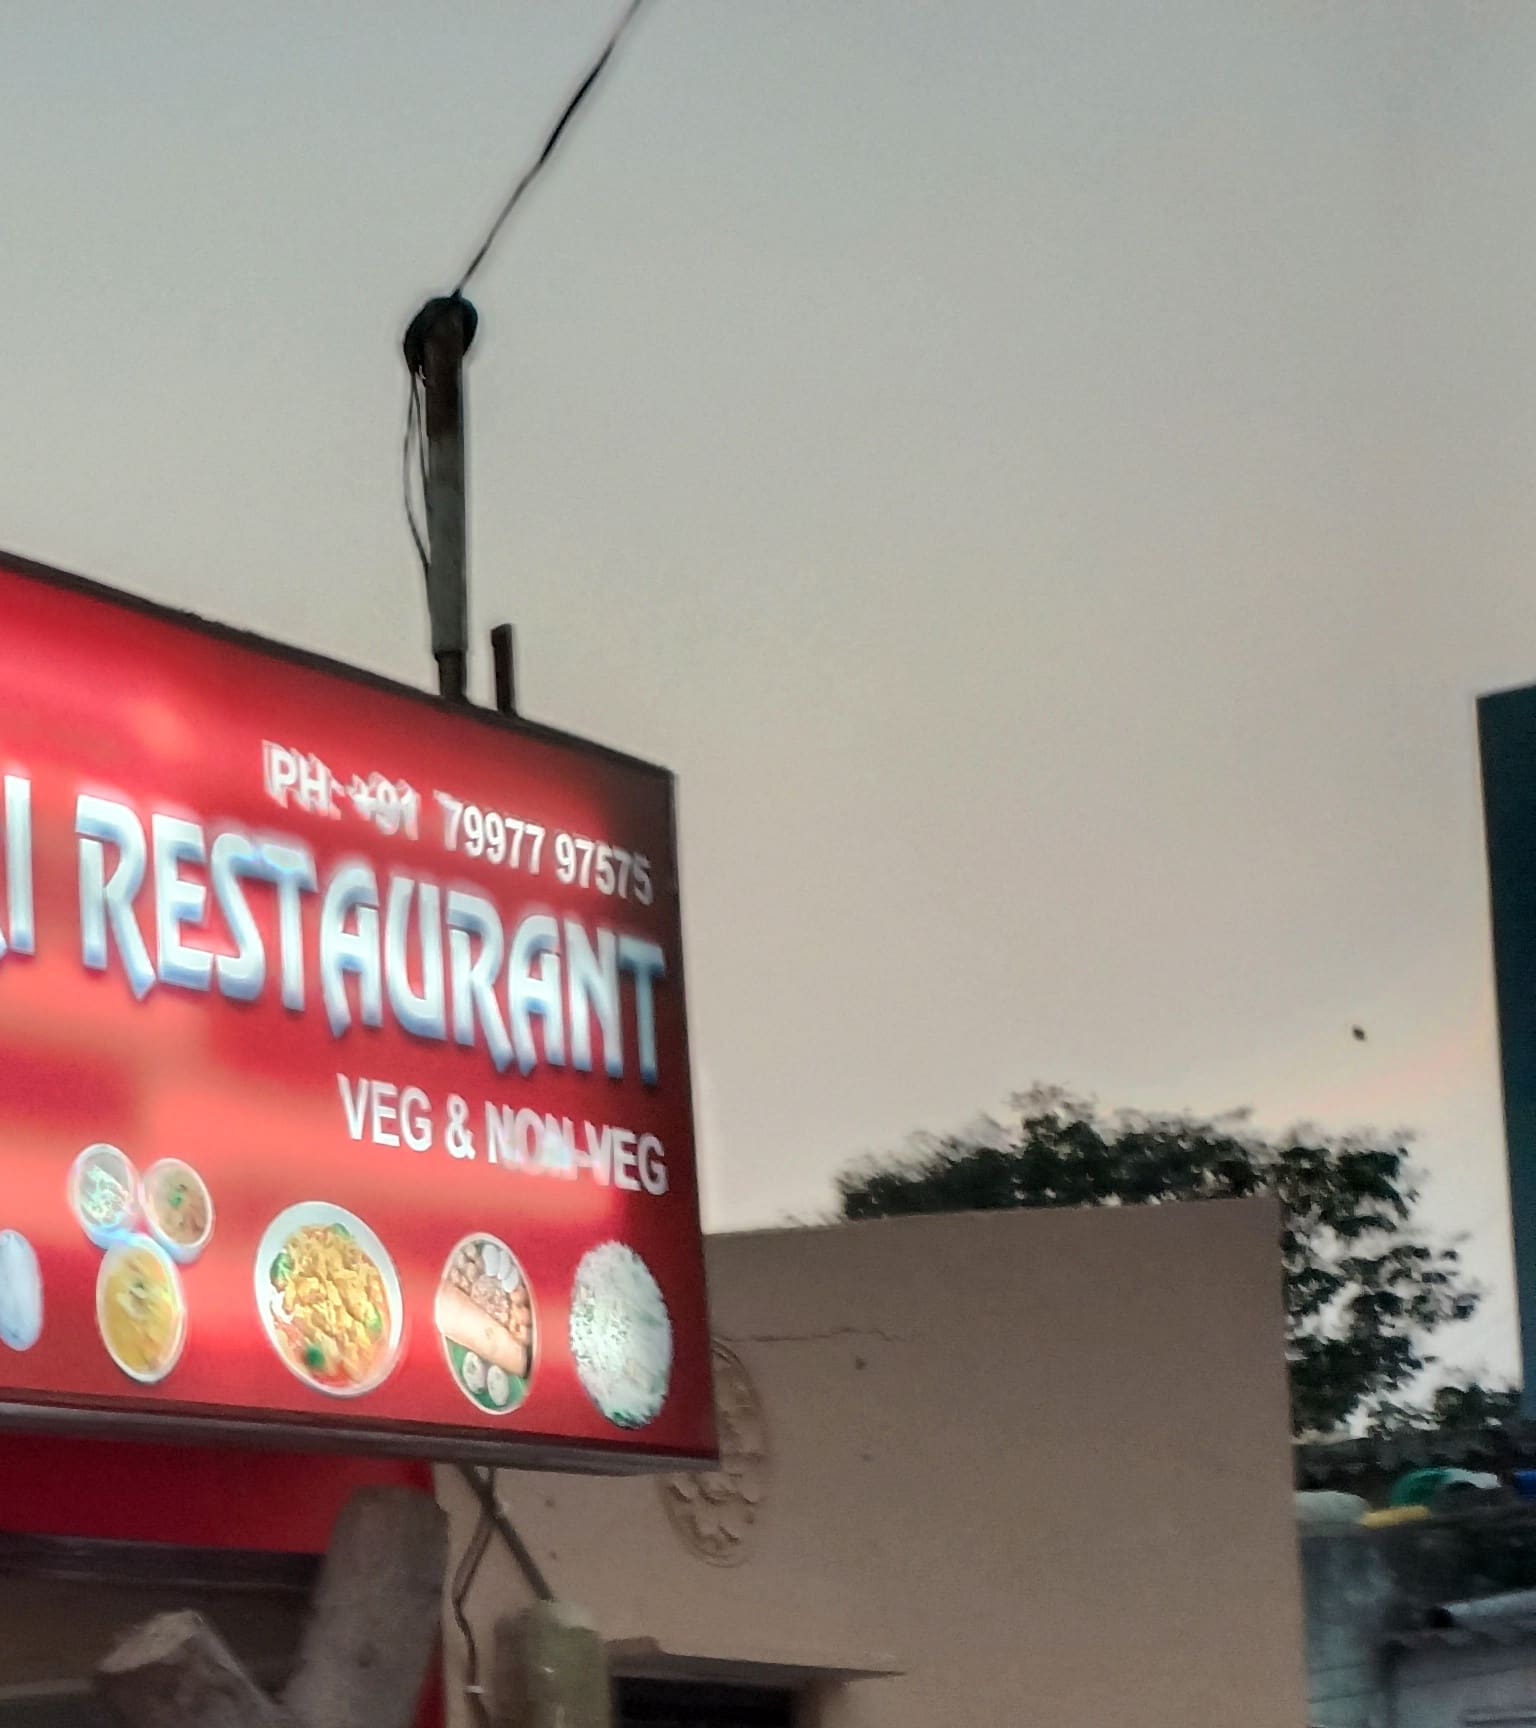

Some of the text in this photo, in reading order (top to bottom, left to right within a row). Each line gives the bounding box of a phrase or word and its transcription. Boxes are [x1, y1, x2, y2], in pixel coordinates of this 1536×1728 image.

[433, 789, 545, 876] 79977
[555, 831, 654, 906] 97575
[74, 793, 666, 1085] RESTAURANT
[336, 1072, 670, 1196] VEG & NON-VEG
